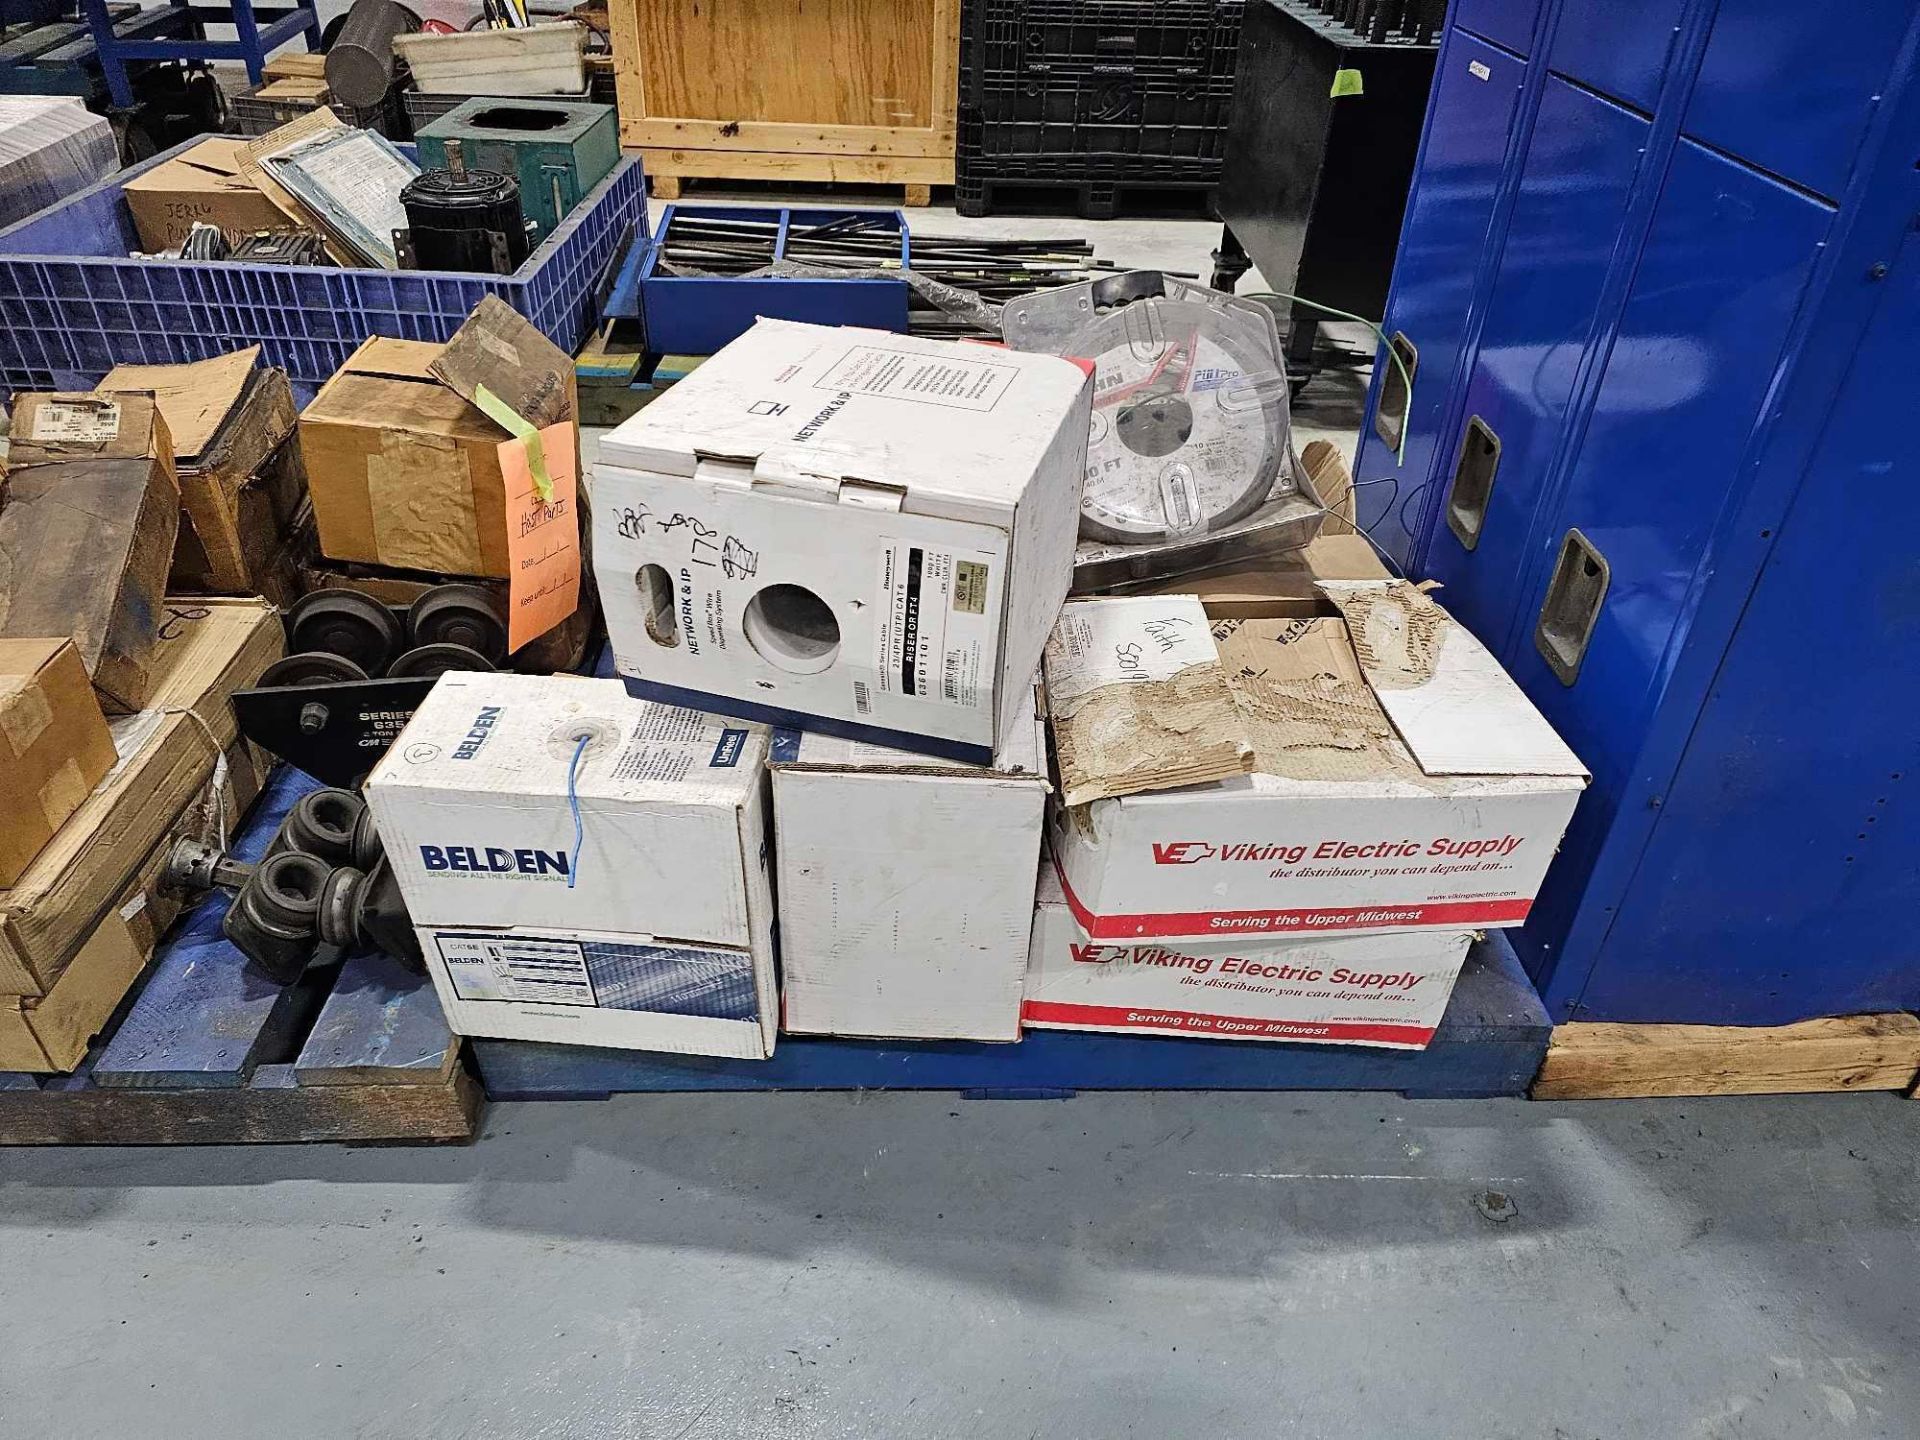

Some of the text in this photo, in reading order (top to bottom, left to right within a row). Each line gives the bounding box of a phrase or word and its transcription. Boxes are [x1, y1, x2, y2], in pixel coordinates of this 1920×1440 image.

[791, 406, 841, 442] NETWORK
[837, 392, 852, 400] IP
[1104, 457, 1121, 473] FT
[690, 517, 719, 567] 178
[680, 568, 700, 655] NETWORK & IP
[714, 590, 722, 616] System
[896, 591, 905, 610] CAT
[906, 597, 919, 663] RISER OR FT4
[373, 720, 405, 730] 635
[451, 706, 501, 760] BELDEN
[716, 734, 739, 764] UnReel
[419, 845, 570, 876] BELDEN
[1220, 843, 1308, 864] Viking
[1313, 840, 1421, 859] Electric
[1426, 835, 1524, 859] Supply
[427, 871, 468, 880] SENDING
[470, 872, 486, 880] ALL
[505, 873, 531, 882] RIGHT
[1269, 868, 1293, 879] the
[1296, 866, 1370, 878] distributor
[1370, 868, 1399, 878] you
[1402, 867, 1427, 875] can
[1430, 861, 1481, 875] depend
[1210, 910, 1423, 928] Serving the Upper Midwest
[447, 957, 485, 965] BELDEN
[1133, 947, 1214, 974] Viking
[1219, 957, 1322, 982] Electric
[1329, 968, 1426, 990] Supply
[1180, 976, 1202, 986] the
[1205, 978, 1275, 995] distributor
[1276, 987, 1302, 998] you
[1334, 990, 1384, 1001] depend
[1126, 1012, 1330, 1035] Serving the Upper Midwest
